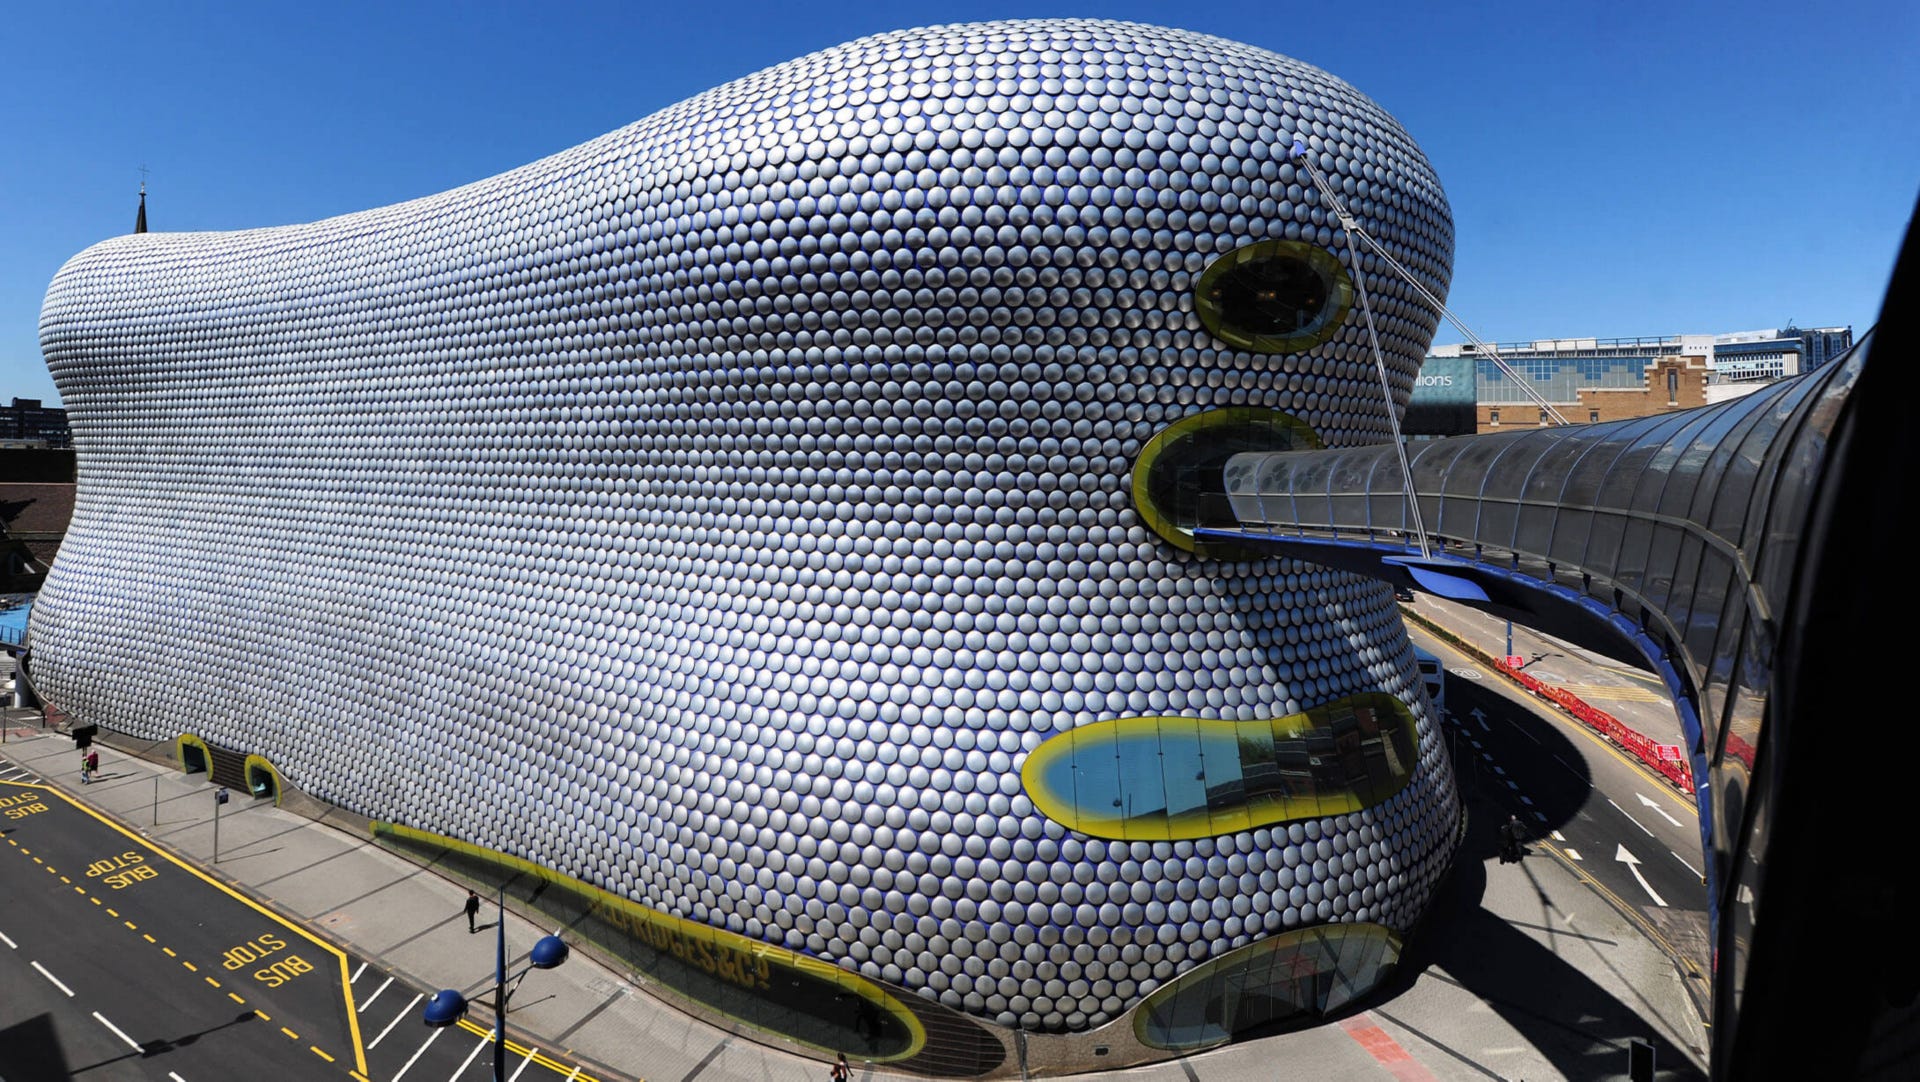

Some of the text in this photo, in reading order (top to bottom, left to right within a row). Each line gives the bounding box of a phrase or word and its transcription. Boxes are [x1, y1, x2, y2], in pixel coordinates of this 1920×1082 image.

[0, 791, 39, 809] STO
[4, 802, 49, 820] BUS
[85, 851, 145, 878] STOP
[103, 864, 159, 890] BUS
[222, 932, 287, 971] STOP
[253, 954, 315, 988] BUS
